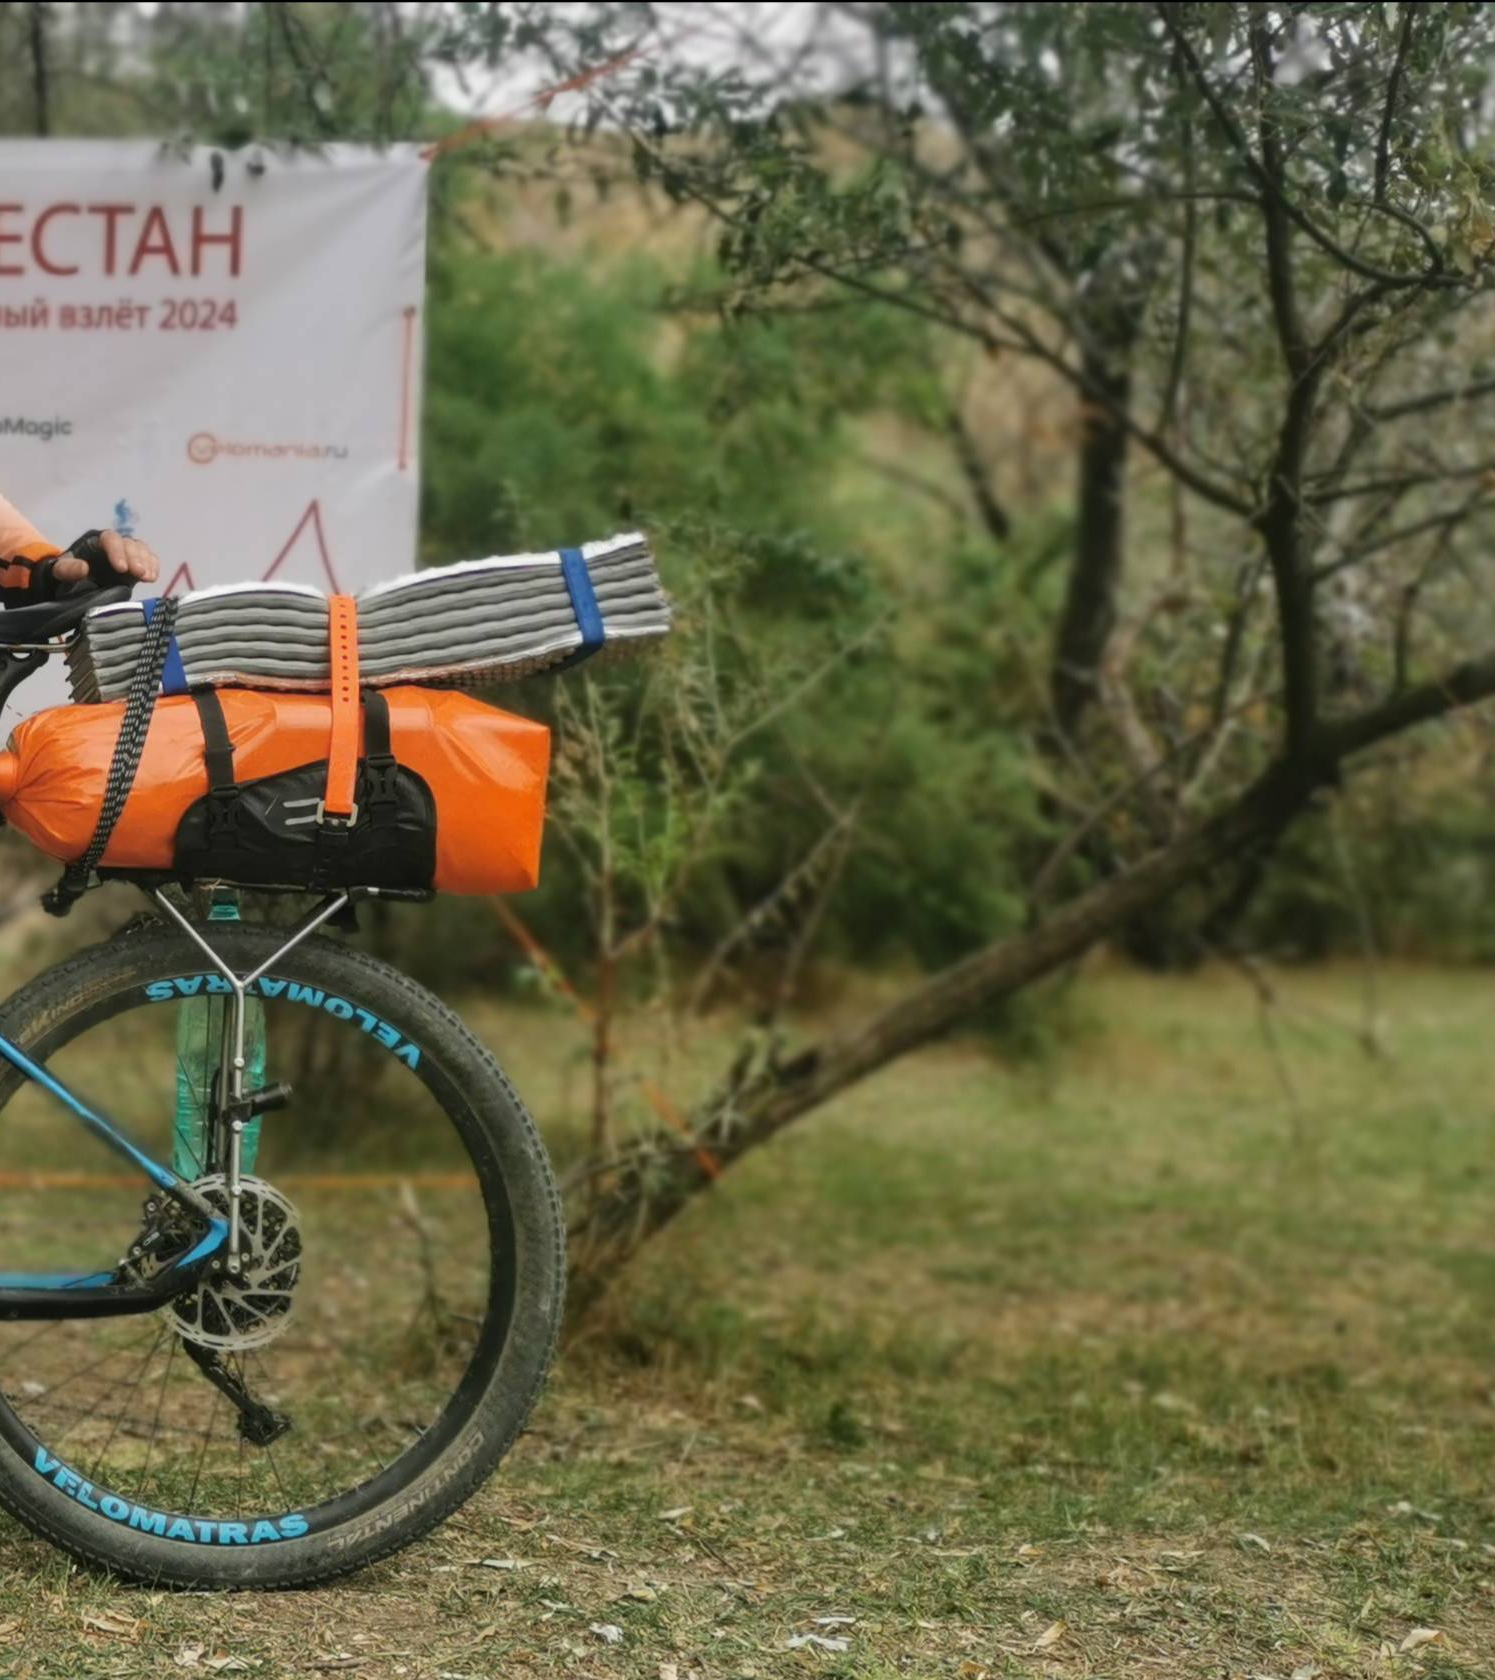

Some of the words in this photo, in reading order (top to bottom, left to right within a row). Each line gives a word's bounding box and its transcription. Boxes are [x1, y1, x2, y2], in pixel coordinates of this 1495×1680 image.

[59, 302, 149, 330] взлёт
[158, 302, 237, 331] 2024
[147, 974, 421, 1070] VELOMARAS
[33, 1445, 309, 1546] VELOMATRAS
